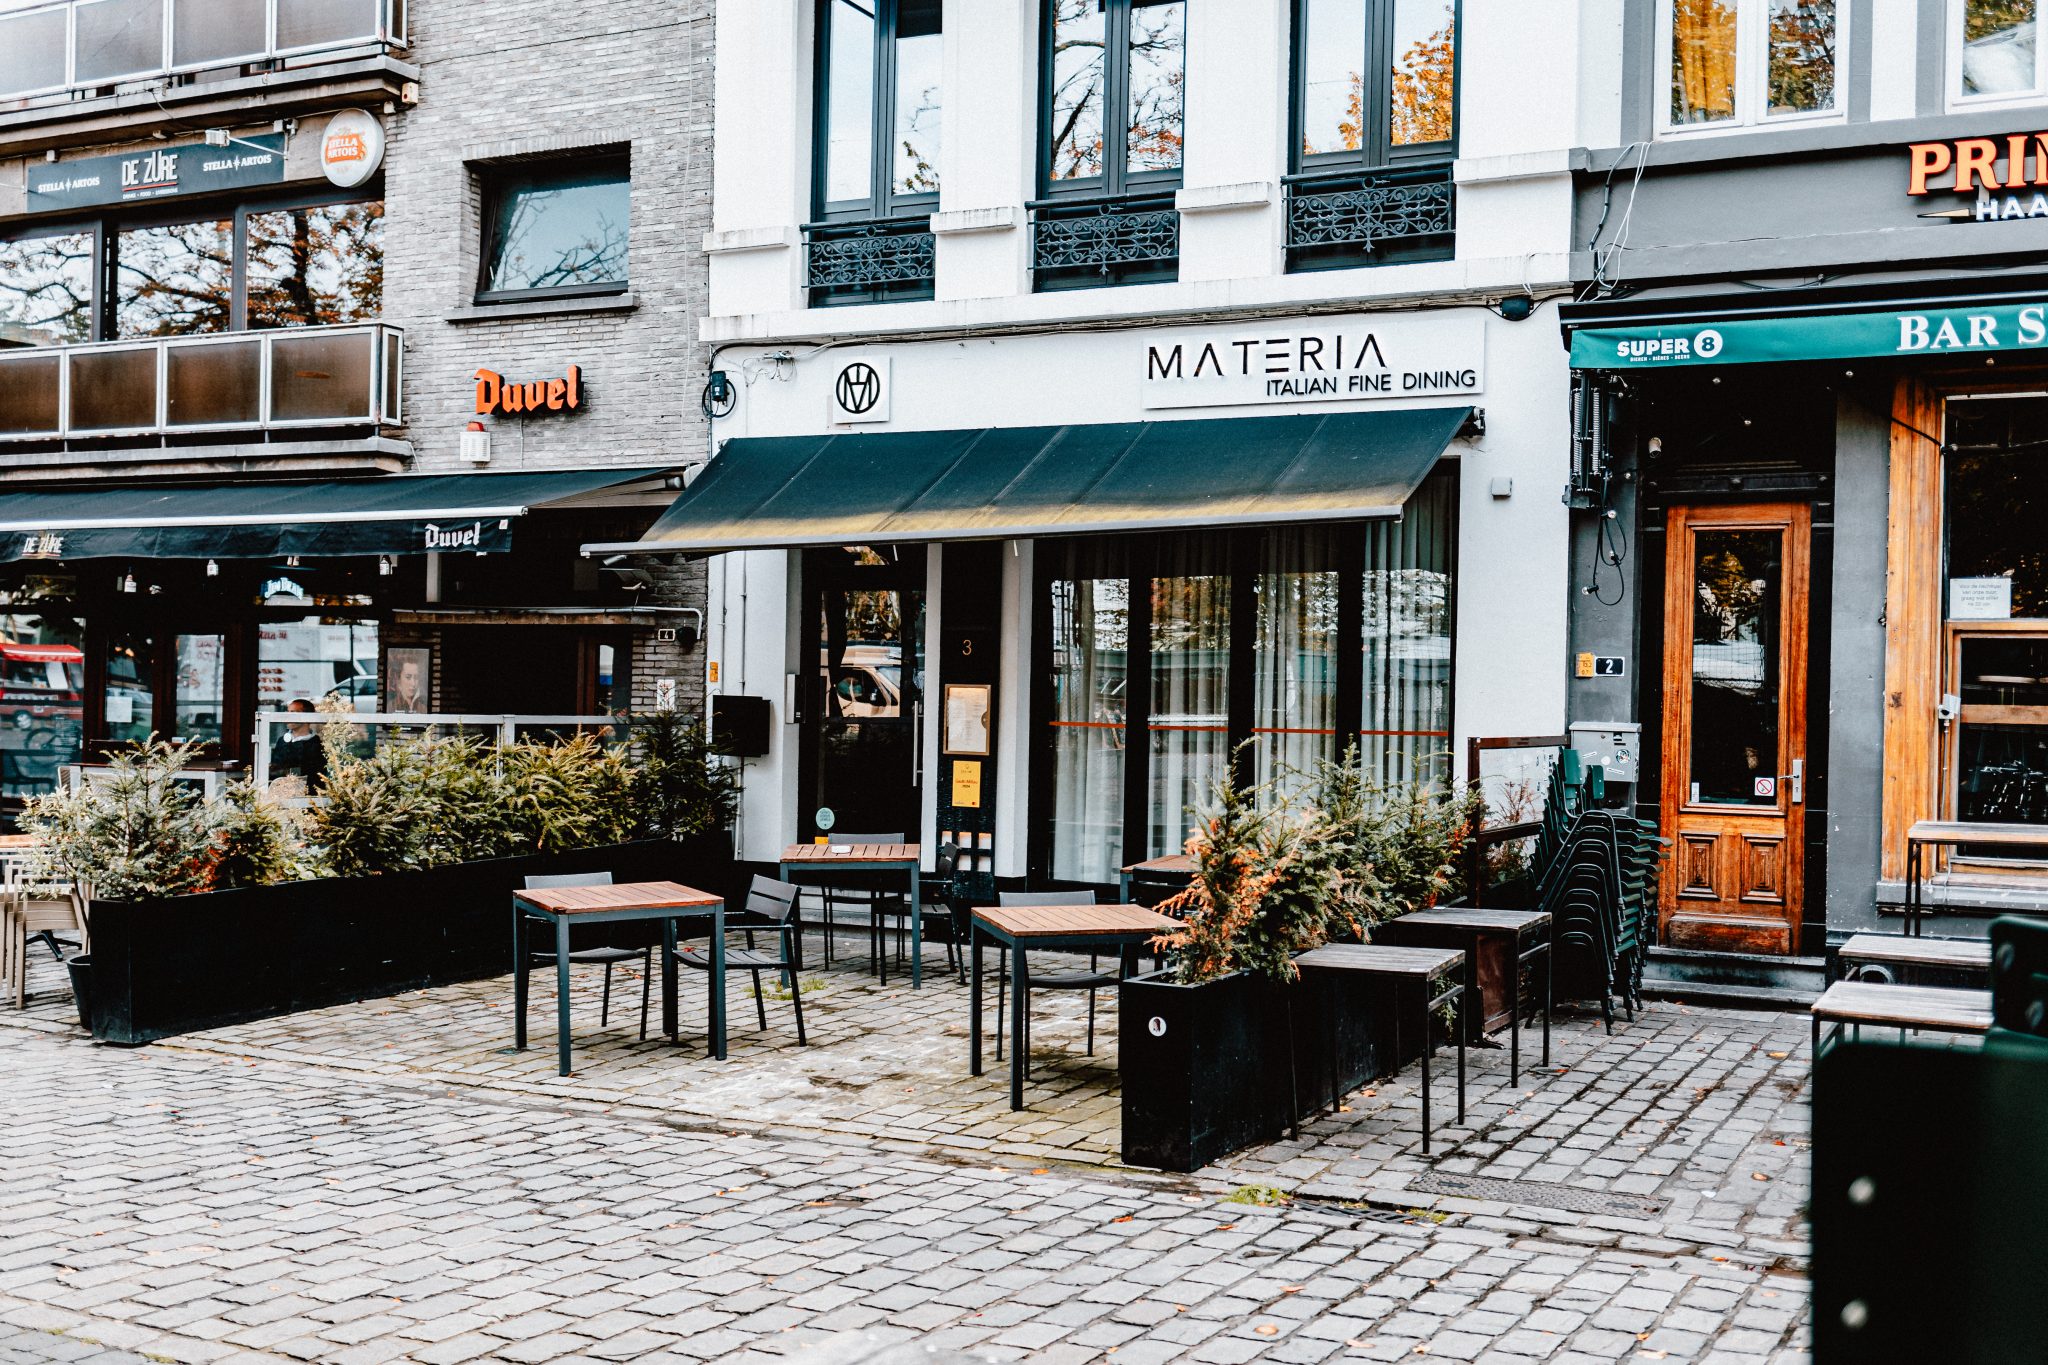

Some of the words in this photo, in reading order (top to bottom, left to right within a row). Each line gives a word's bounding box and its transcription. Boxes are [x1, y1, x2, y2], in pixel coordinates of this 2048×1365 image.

[327, 147, 358, 158] ARTOIS
[122, 159, 139, 186] DE
[144, 150, 178, 183] ZURE
[203, 159, 233, 172] STELLA
[241, 154, 272, 167] ARTOIS
[37, 183, 65, 193] STELLA
[72, 176, 100, 189] ARTOIS
[1896, 315, 1999, 351] BAR
[1148, 333, 1387, 381] MATERIA
[1617, 338, 1690, 357] SUPER
[473, 364, 582, 415] Duvel
[1266, 376, 1337, 396] ITALIAN
[1348, 373, 1392, 393] FINE
[1402, 369, 1477, 390] DINING
[424, 521, 481, 548] Duvel
[23, 536, 38, 553] DE
[961, 639, 972, 656] 3
[1605, 658, 1614, 674] 2
